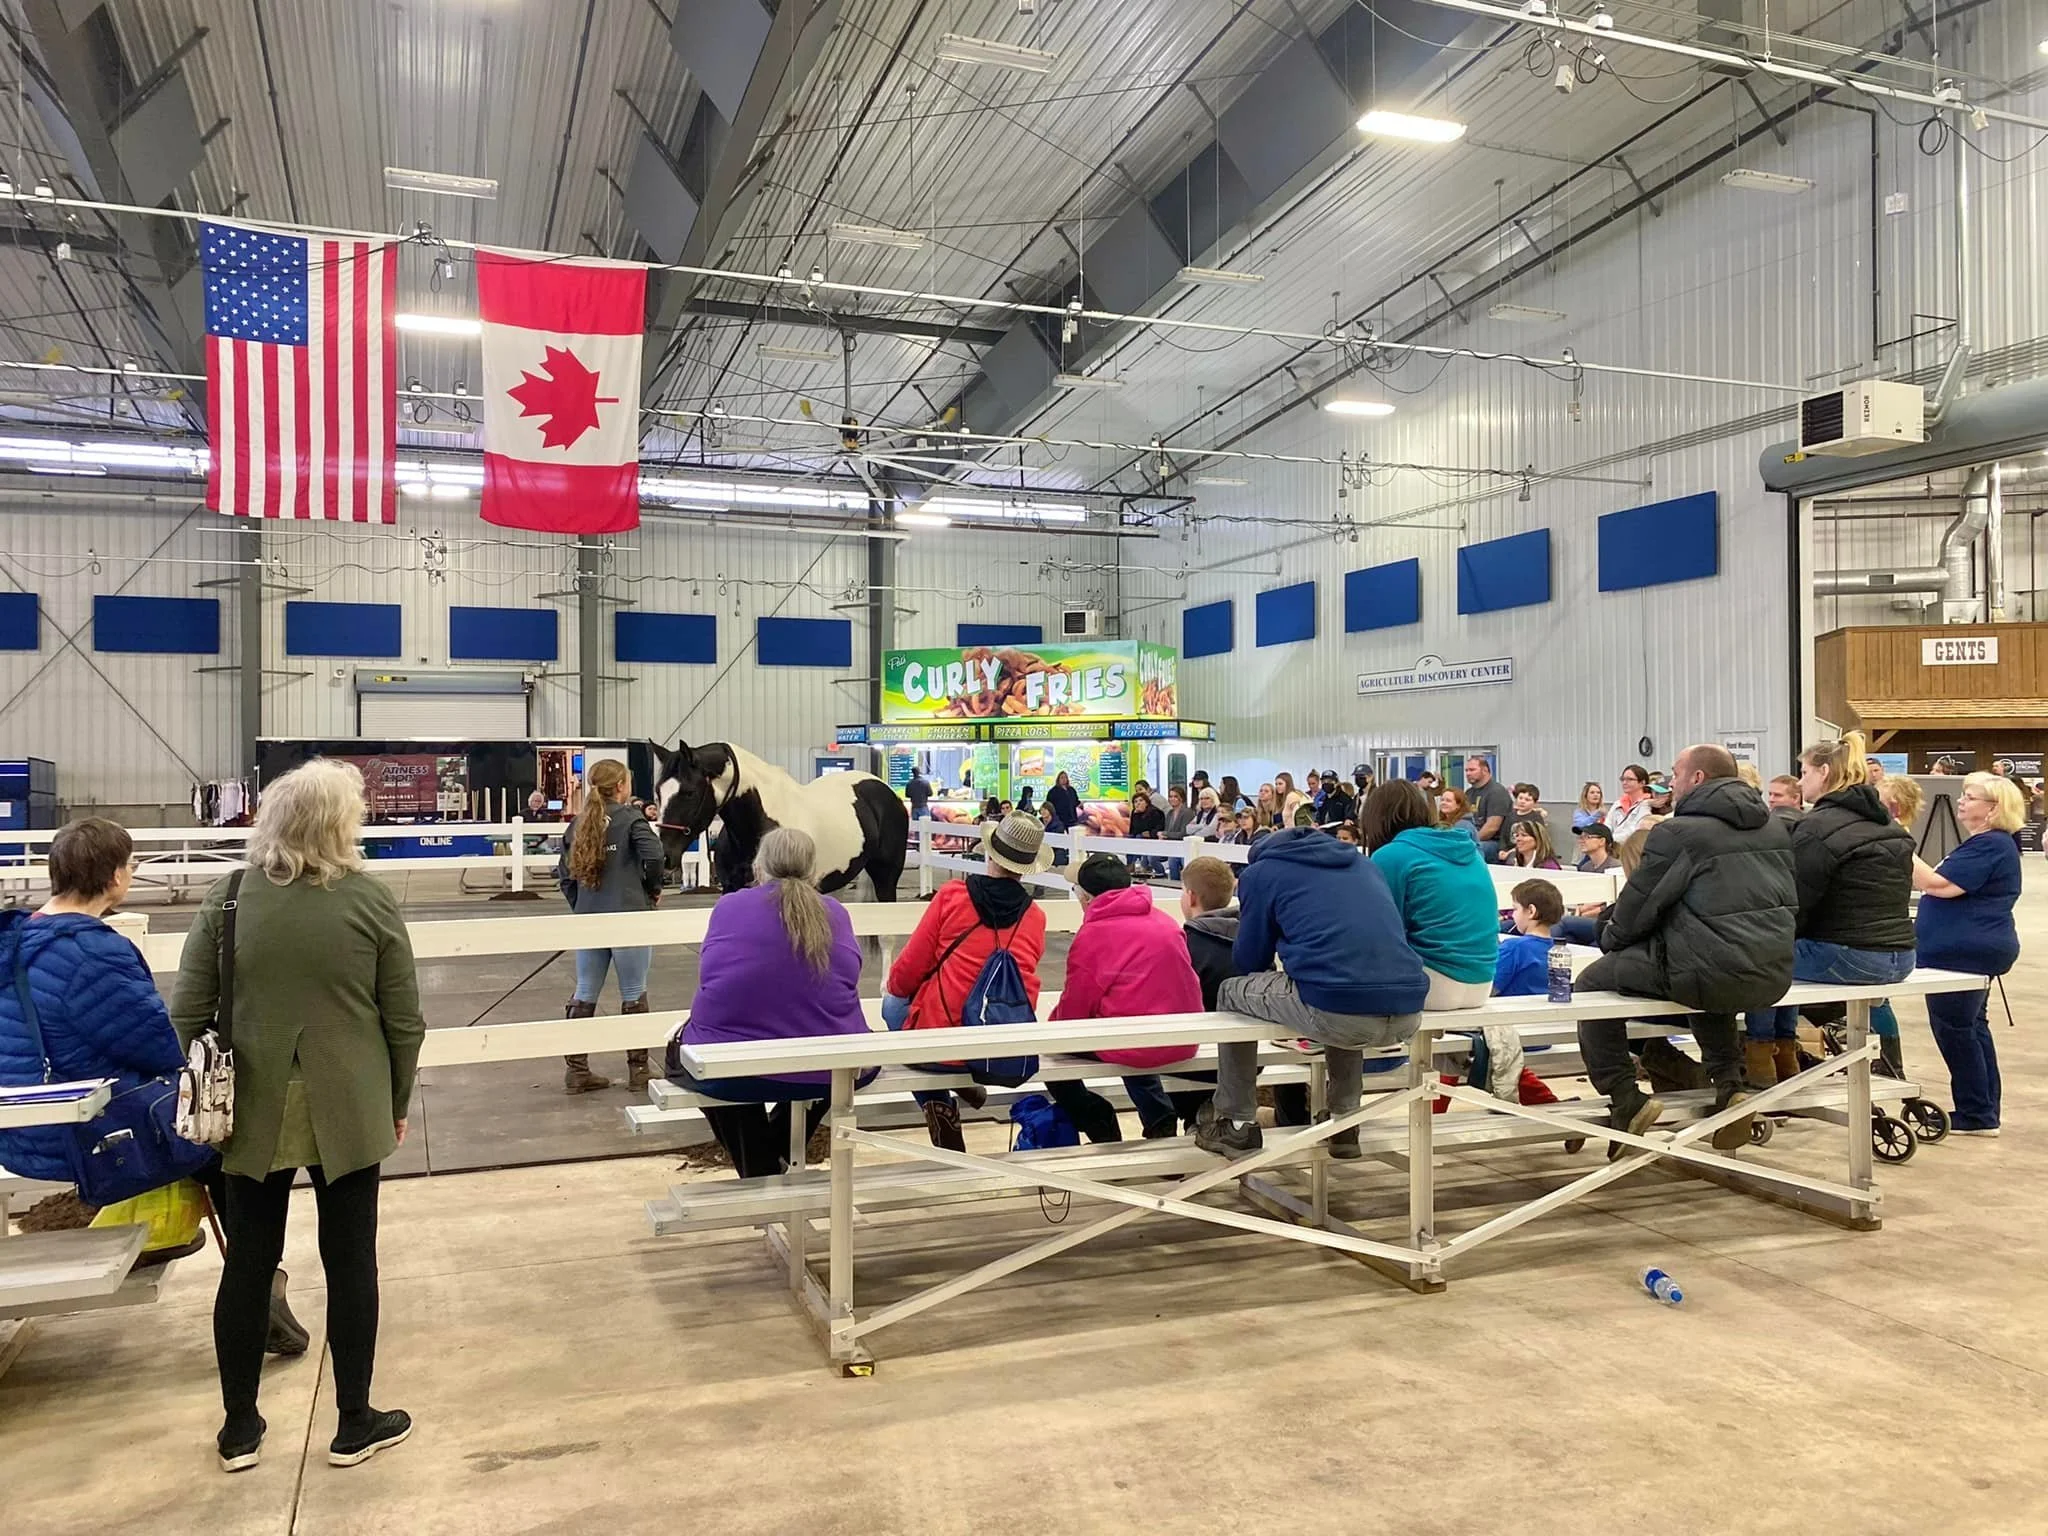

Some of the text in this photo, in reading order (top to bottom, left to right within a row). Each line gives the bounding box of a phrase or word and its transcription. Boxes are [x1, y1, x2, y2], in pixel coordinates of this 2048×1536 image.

[1935, 641, 1986, 661] GENTS
[902, 655, 1126, 710] CURLY FRIES
[1359, 664, 1510, 689] AGRICULTURE DISCOVERY CENTER
[996, 727, 1049, 737] PIZZA LOGS
[1120, 729, 1160, 737] BOTTLED
[419, 837, 453, 846] ONLINE
